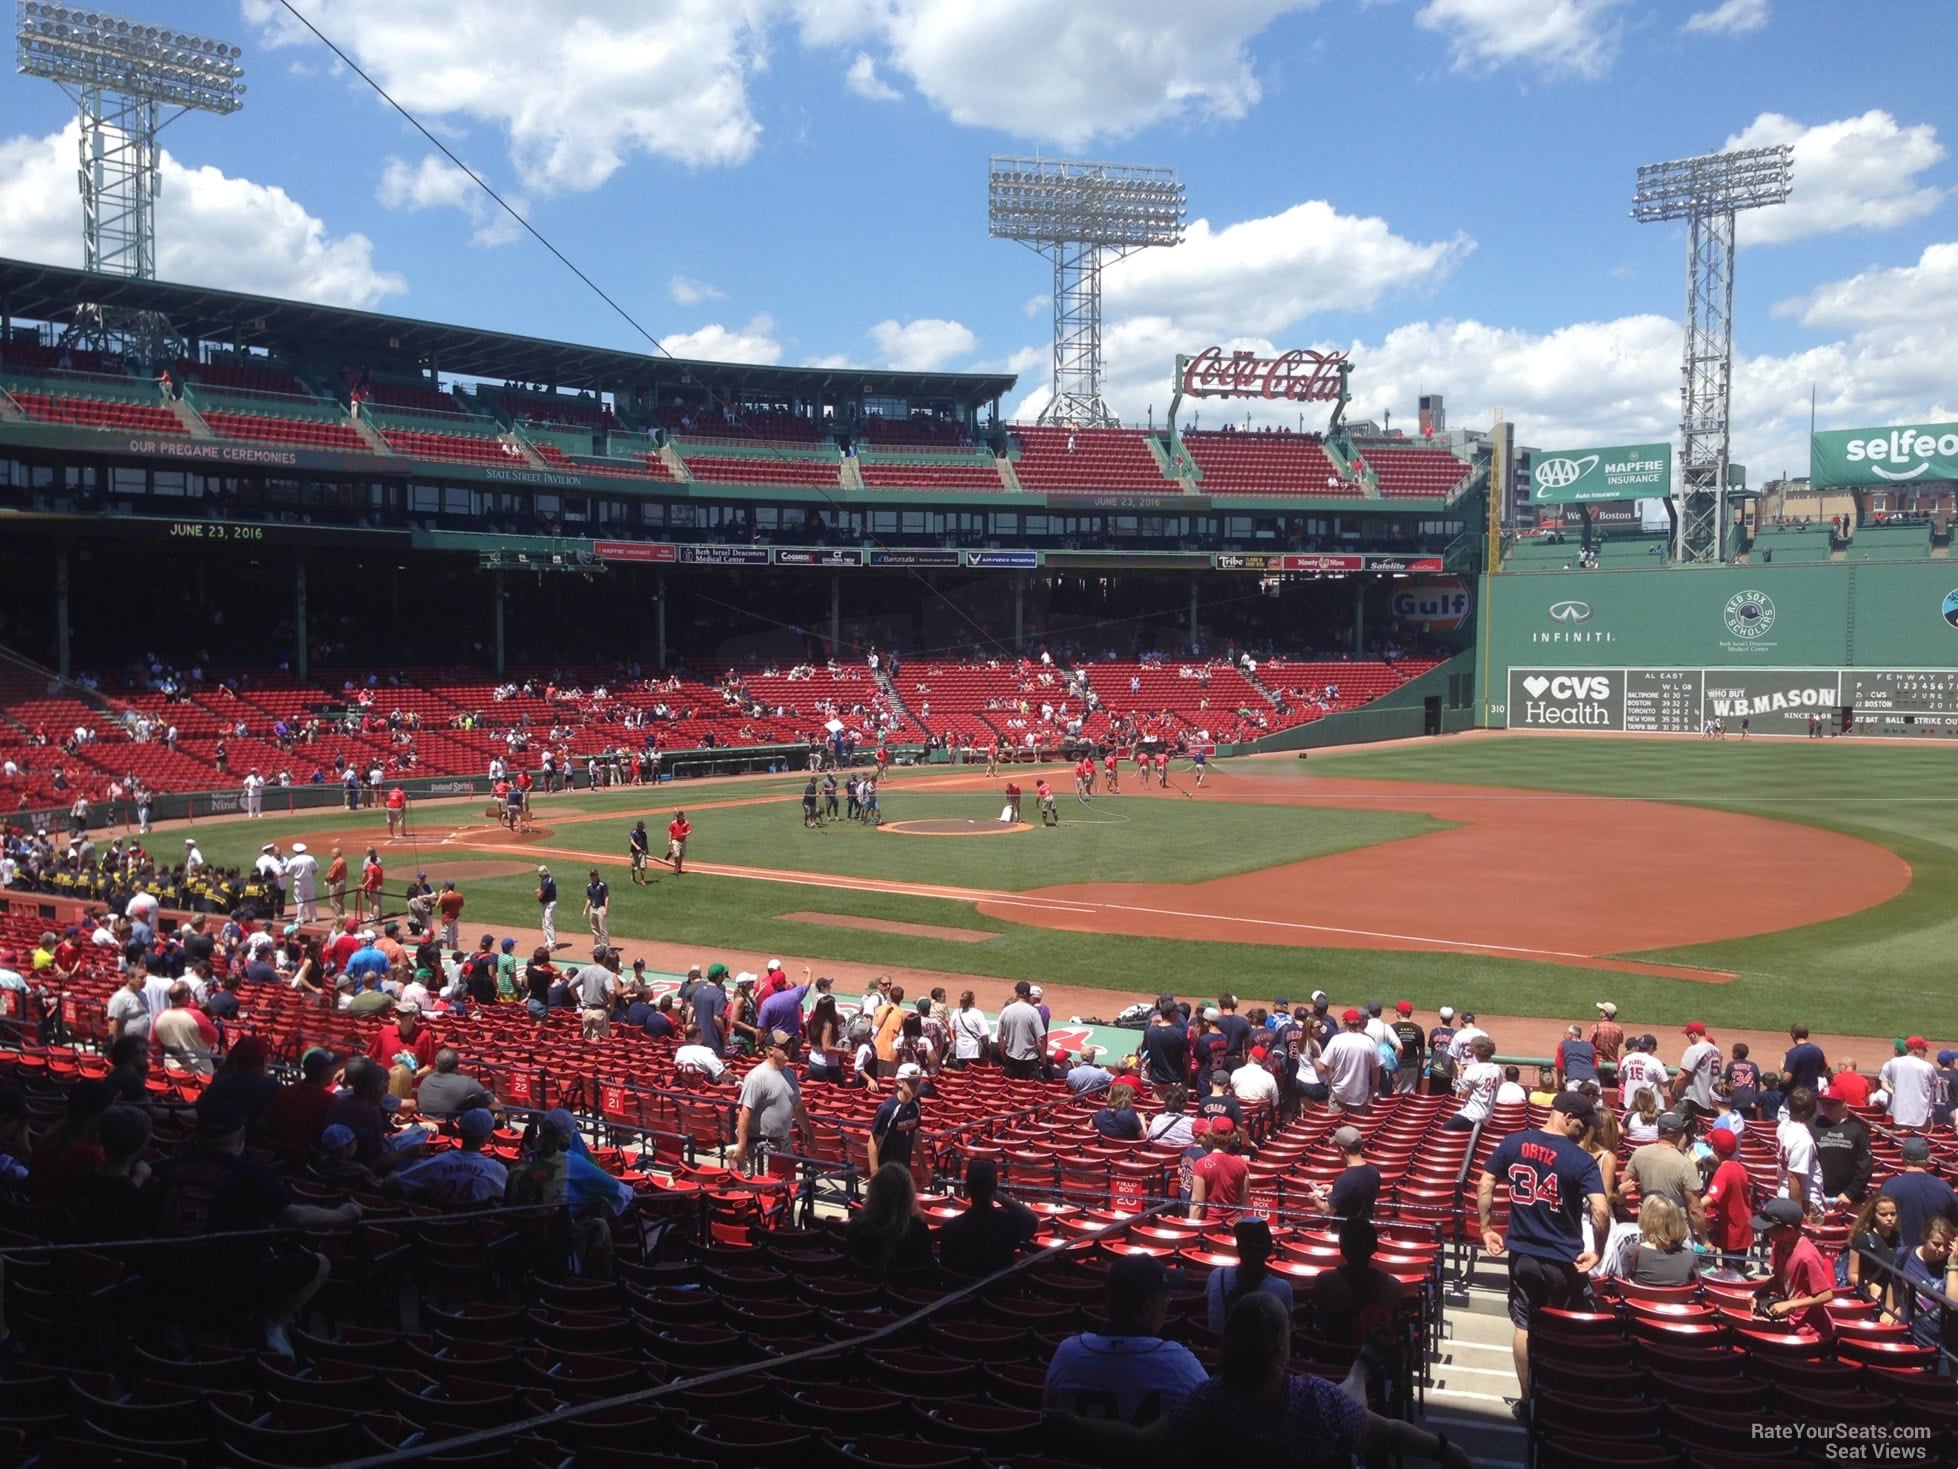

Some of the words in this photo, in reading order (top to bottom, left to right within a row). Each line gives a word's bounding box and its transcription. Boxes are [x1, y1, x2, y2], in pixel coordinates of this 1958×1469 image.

[1184, 346, 1350, 400] Coca-Cola
[129, 440, 156, 453] OUR
[160, 443, 219, 458] PREGAME
[223, 448, 296, 464] CEREMONIES
[1540, 459, 1575, 486] AAA
[1604, 460, 1663, 474] MAPFRE
[486, 469, 511, 480] STATE
[512, 470, 540, 482] STREET
[544, 473, 581, 485] PAVILION
[1607, 474, 1659, 485] INSURANCE
[1094, 498, 1118, 506] JUNE
[1121, 498, 1136, 508] 23,
[1139, 498, 1160, 507] 2016
[1566, 512, 1581, 520] We
[1599, 511, 1631, 520] Boston
[170, 524, 203, 536] JUNE
[208, 526, 228, 539] 23,
[234, 527, 263, 539] 2016
[695, 548, 711, 556] Beth
[1219, 556, 1243, 568] Tribe
[1370, 562, 1406, 570] Safelite
[1394, 593, 1465, 615] Gulf
[1727, 595, 1744, 613] RED
[1746, 592, 1767, 604] SOX
[1728, 609, 1773, 636] SCHOLARS
[1533, 632, 1611, 642] INFINITI
[1551, 676, 1610, 700] CVS
[1706, 689, 1727, 698] WHO
[1728, 689, 1745, 698] BUT
[1491, 705, 1504, 714] 310
[1525, 701, 1610, 725] Health
[211, 800, 237, 811] Nine
[1629, 1067, 1643, 1080] 15
[1731, 1071, 1753, 1088] 34
[515, 1083, 527, 1093] 22
[608, 1099, 619, 1109] 21
[1521, 1142, 1558, 1166] ORTIZ
[1508, 1163, 1563, 1213] 34
